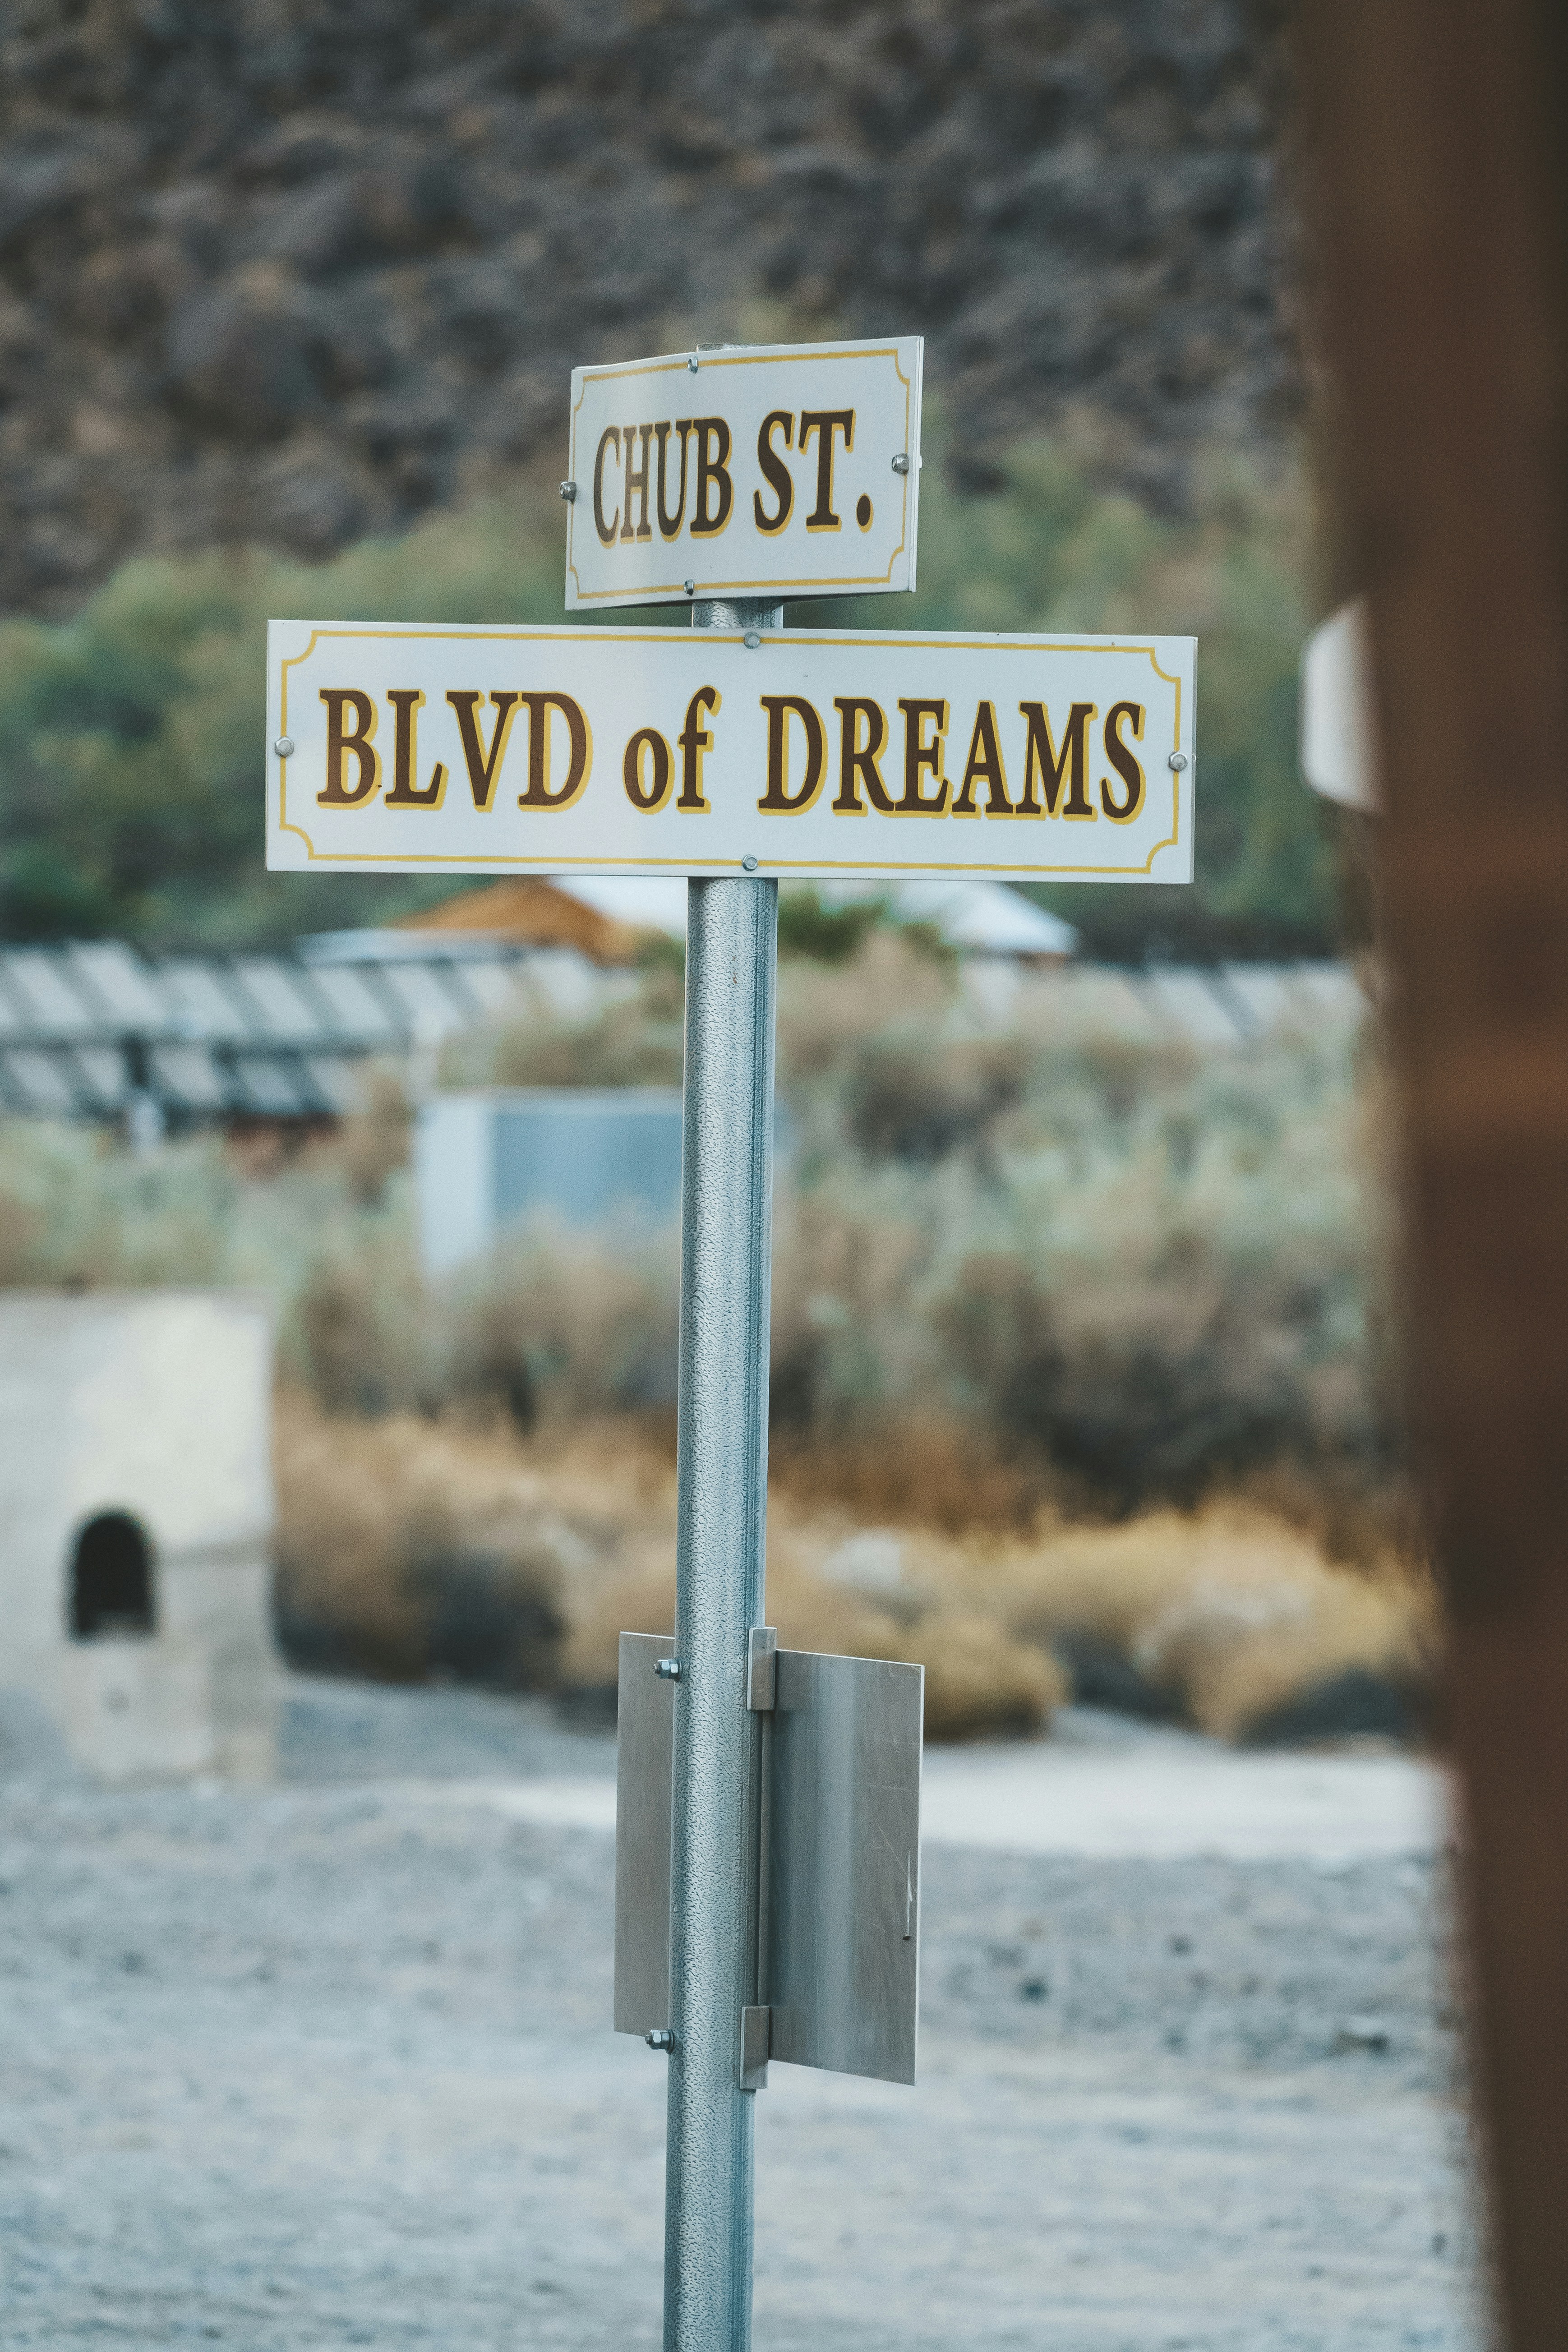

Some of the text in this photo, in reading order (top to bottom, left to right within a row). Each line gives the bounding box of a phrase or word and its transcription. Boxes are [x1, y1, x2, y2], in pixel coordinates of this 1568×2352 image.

[593, 408, 874, 549] CHUB ST.
[317, 685, 1147, 826] BLVD of DREAMS
